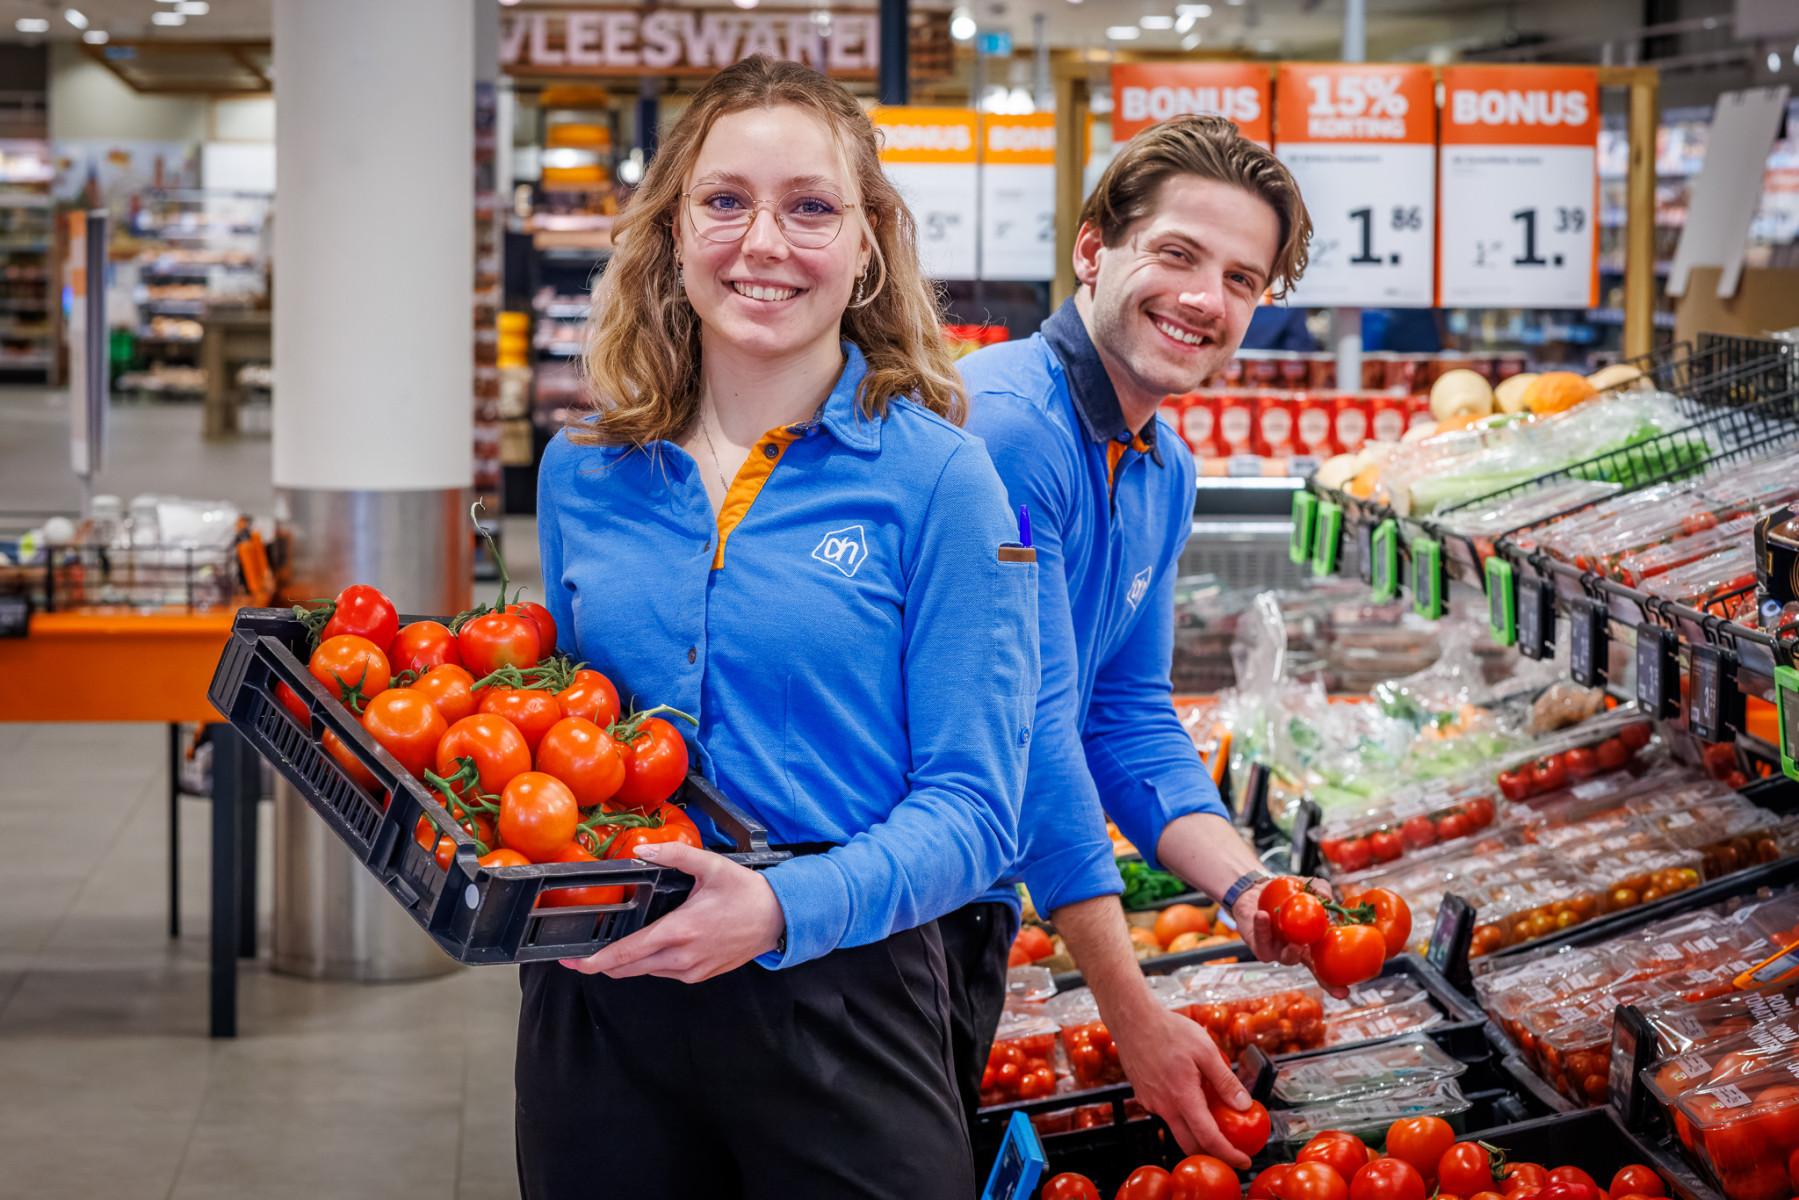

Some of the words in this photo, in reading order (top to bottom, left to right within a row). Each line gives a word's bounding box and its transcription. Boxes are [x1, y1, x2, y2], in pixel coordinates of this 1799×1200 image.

[499, 12, 880, 67] VLEESWARE
[1121, 86, 1262, 122] BONUS
[1307, 76, 1409, 116] 15%
[1452, 89, 1589, 126] BONUS
[1308, 117, 1407, 139] KORTING
